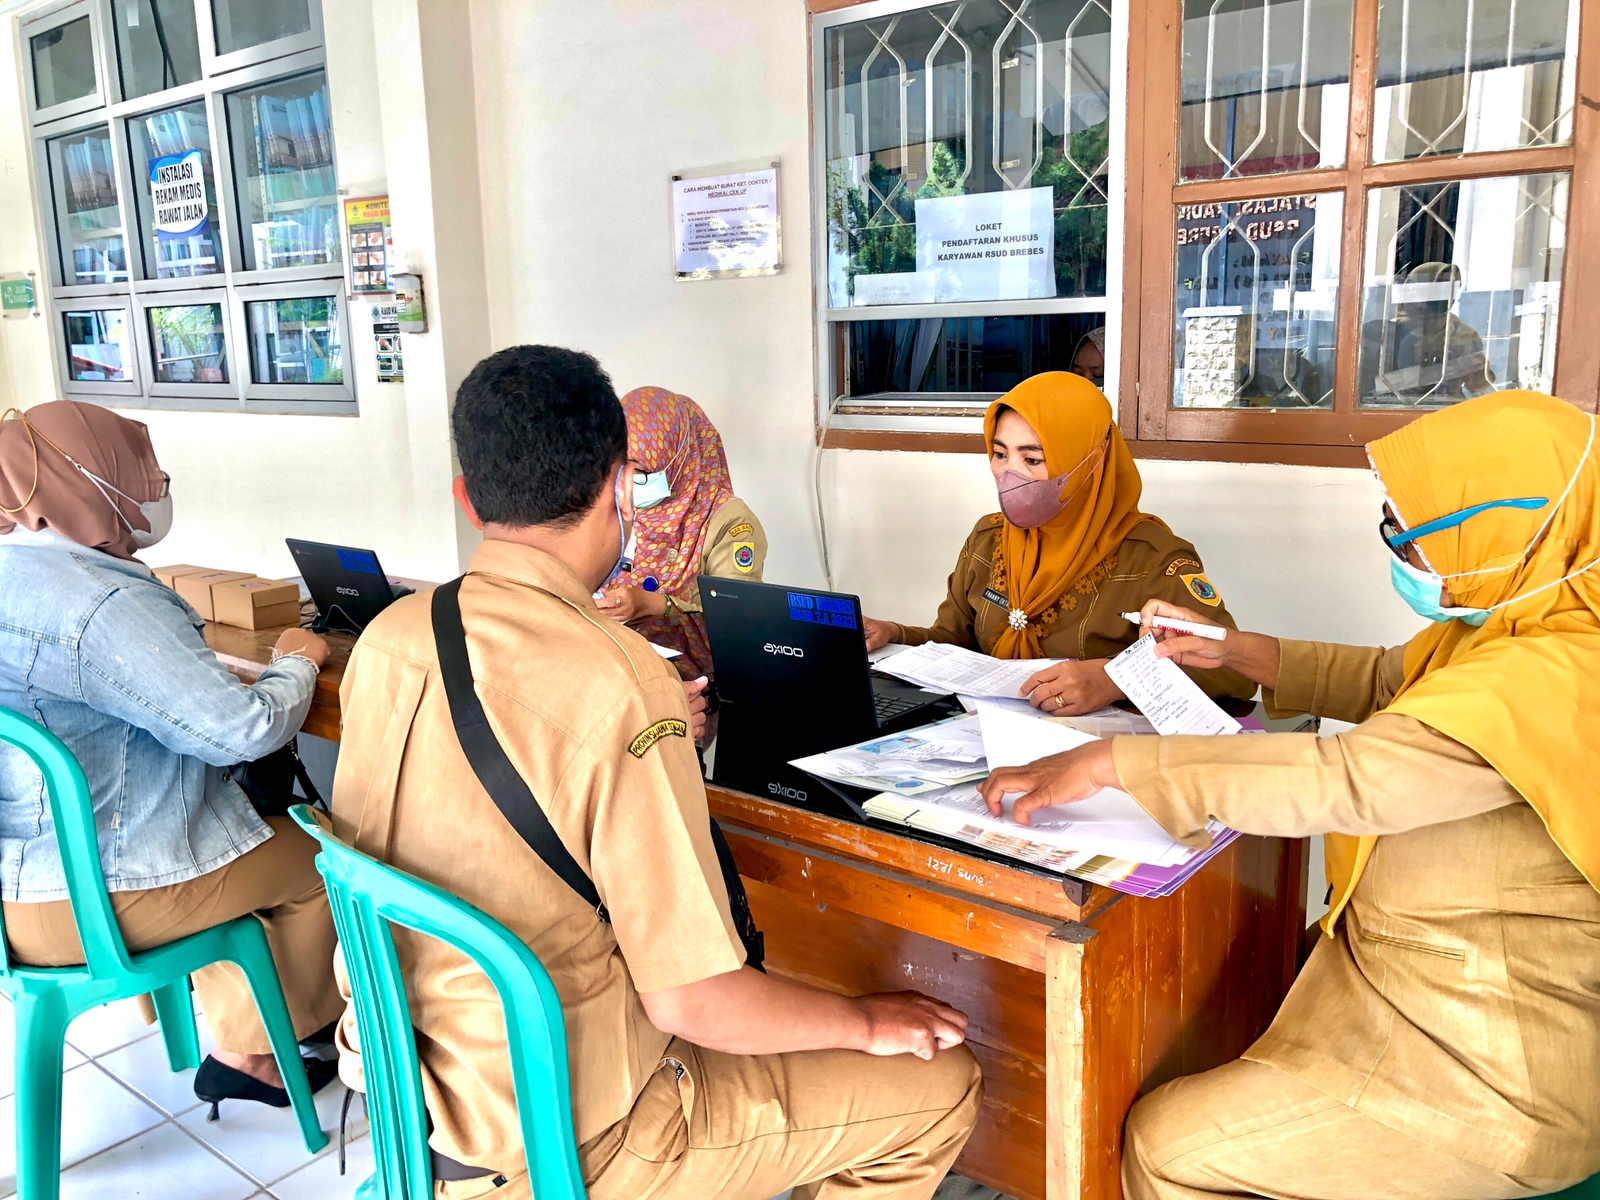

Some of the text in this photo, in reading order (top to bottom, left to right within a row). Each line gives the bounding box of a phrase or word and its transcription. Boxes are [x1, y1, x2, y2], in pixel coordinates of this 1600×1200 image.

[158, 162, 193, 184] INSTALASI
[697, 183, 720, 192] MEMBUAT
[748, 178, 769, 186] DOKTER
[155, 182, 202, 205] REKAM MEDIS
[365, 201, 389, 210] KOMITE
[158, 203, 203, 225] RAWAT JALAN
[362, 210, 379, 219] RSUD
[975, 222, 1003, 232] LOKET
[941, 233, 1039, 248] PENDAFTARAN KHUSUS
[937, 247, 1045, 261] KARYAWAN RSUD BREBES
[789, 594, 853, 615] RSUD BREBES
[632, 731, 656, 753] PROVINSI
